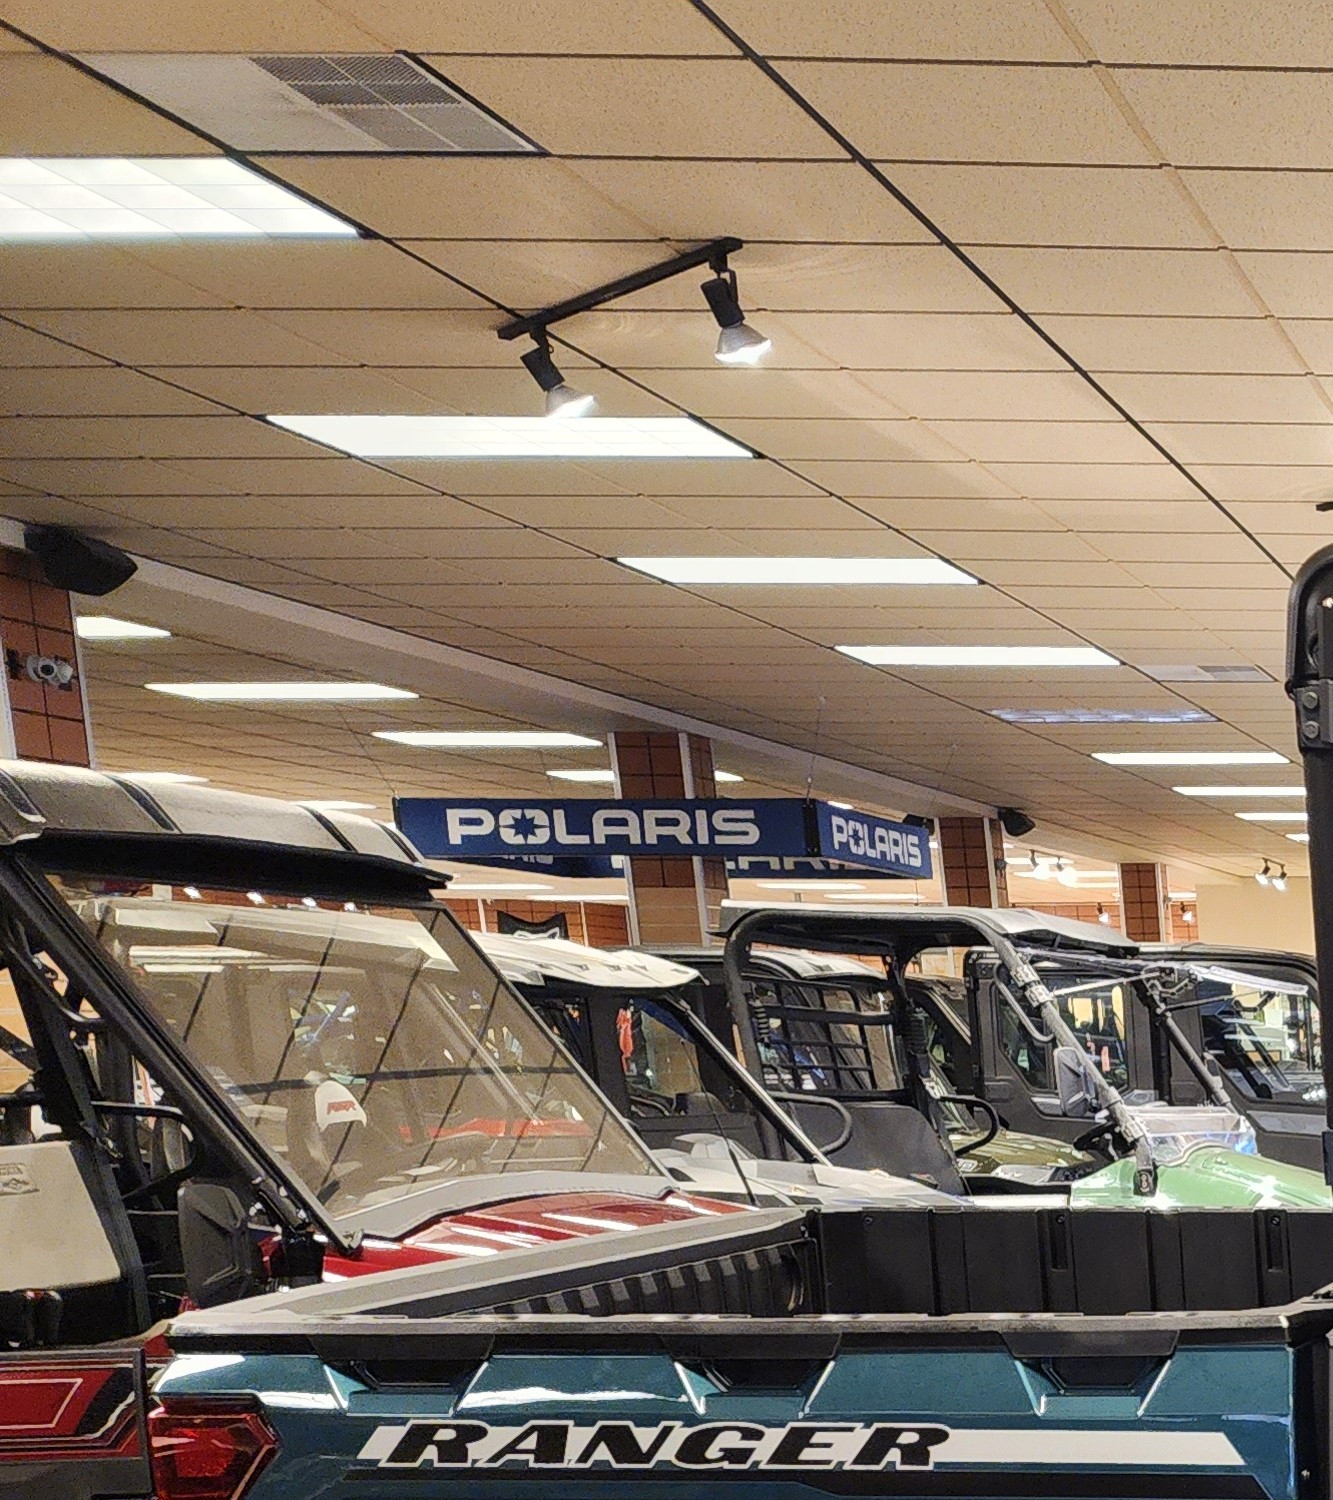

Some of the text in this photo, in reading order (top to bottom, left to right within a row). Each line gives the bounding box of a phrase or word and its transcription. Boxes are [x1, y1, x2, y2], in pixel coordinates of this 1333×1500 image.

[446, 808, 760, 846] POLARIS
[833, 814, 922, 869] POLARIS
[378, 1419, 951, 1470] RANGER
